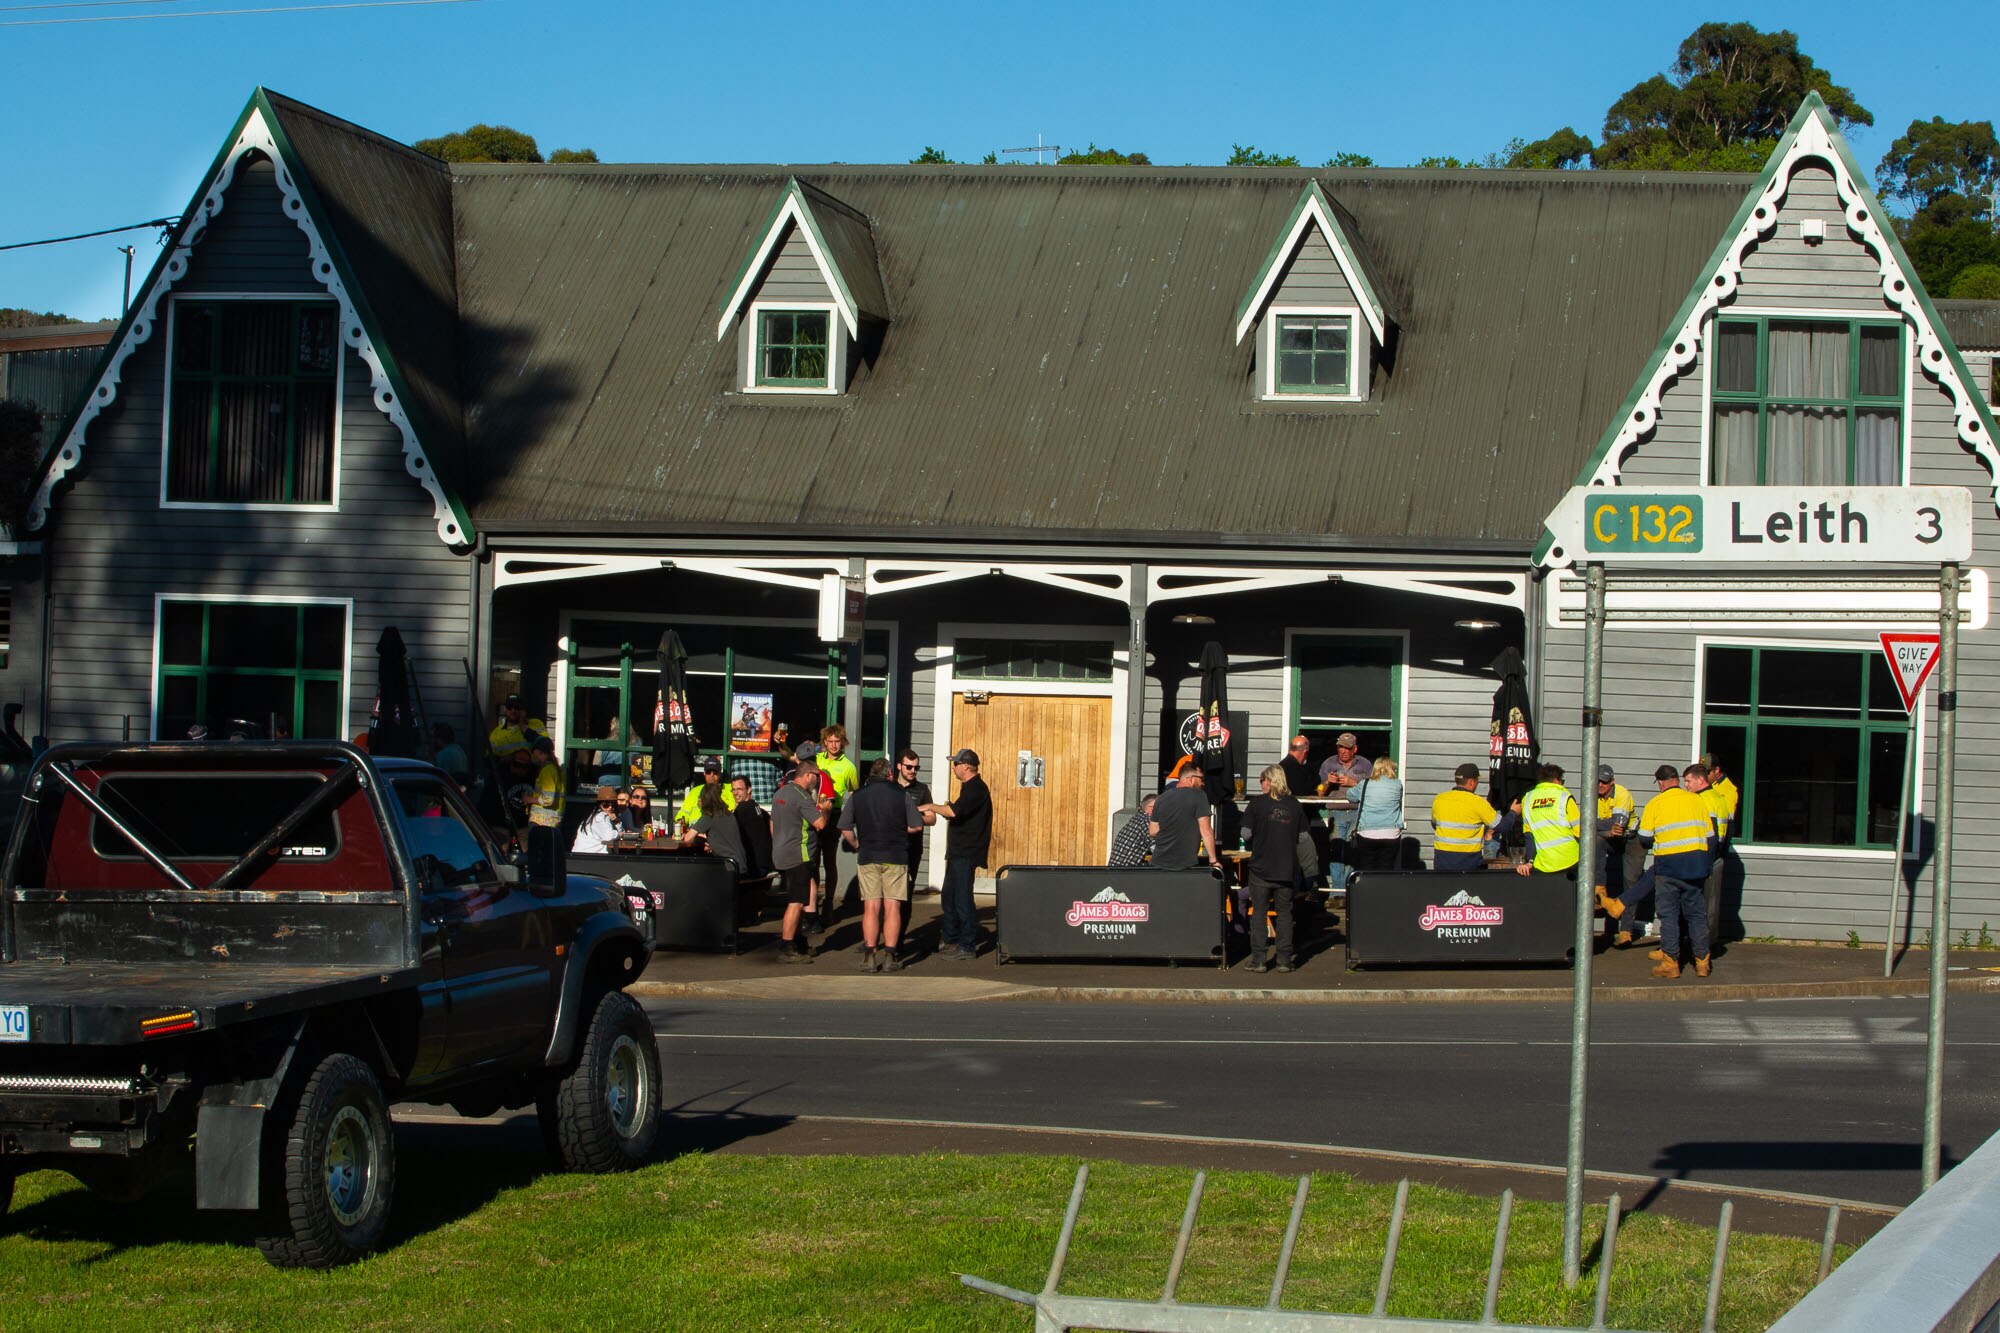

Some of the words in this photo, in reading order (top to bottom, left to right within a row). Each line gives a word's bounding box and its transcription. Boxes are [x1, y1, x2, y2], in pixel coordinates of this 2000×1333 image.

[1593, 504, 1618, 543] C
[1629, 504, 1693, 543] 132
[1731, 501, 1869, 544] Leith
[1915, 507, 1943, 544] 3
[1898, 647, 1929, 660] GIVE
[1902, 663, 1922, 673] WAY
[282, 846, 327, 856] STEDI
[1068, 904, 1109, 922] JAMES
[1111, 904, 1146, 918] BOAG'S
[1421, 908, 1463, 926] JAMES
[1465, 908, 1501, 921] BOAG'S
[1083, 923, 1137, 935] PREMIUM
[1437, 927, 1491, 939] PREMIUM
